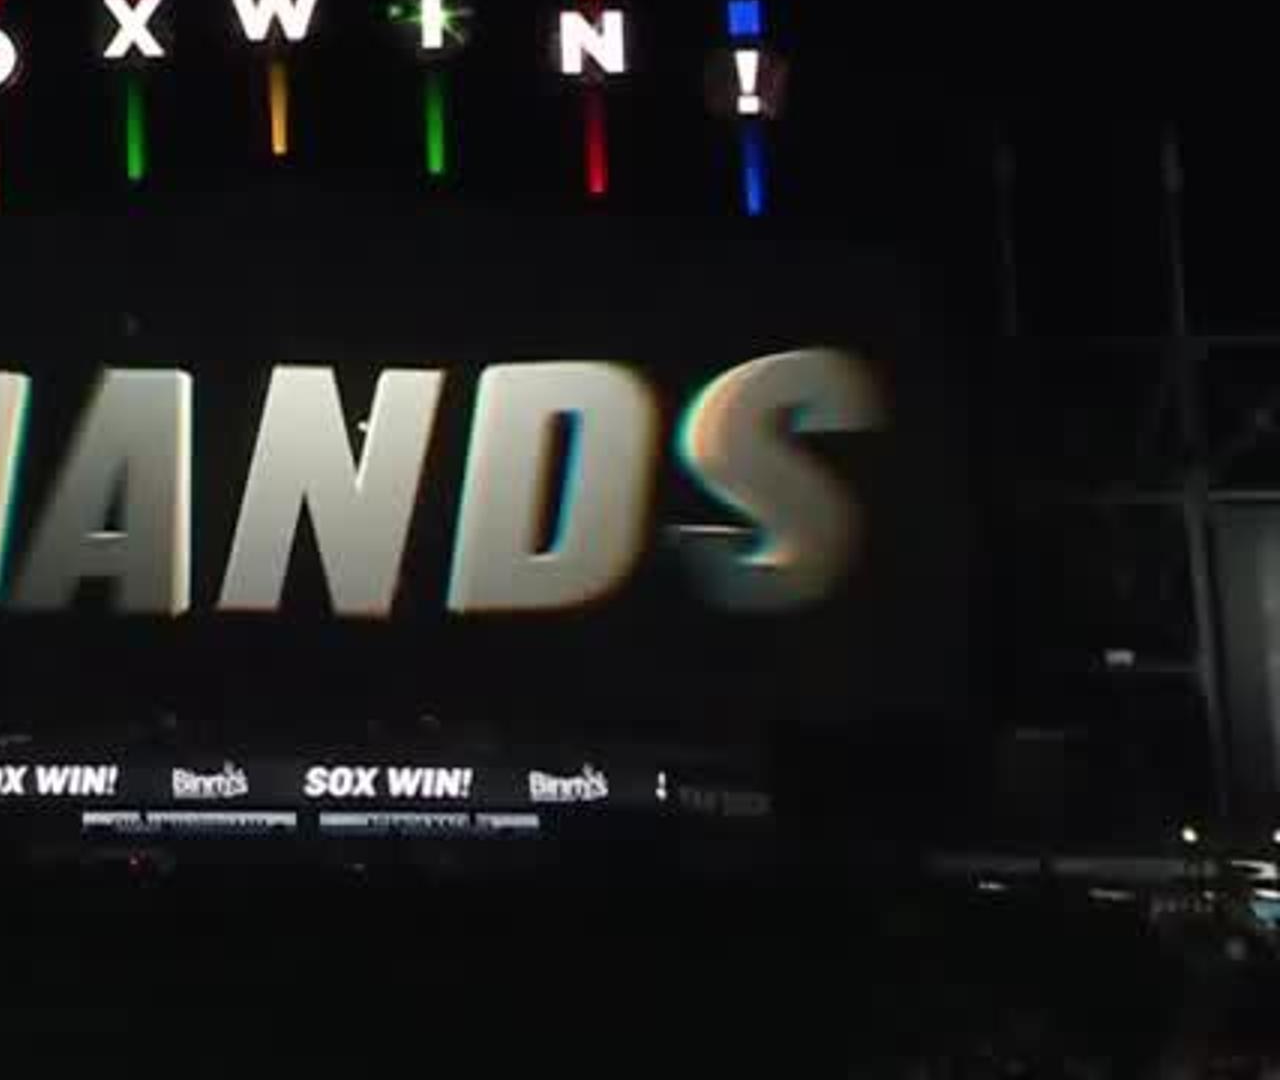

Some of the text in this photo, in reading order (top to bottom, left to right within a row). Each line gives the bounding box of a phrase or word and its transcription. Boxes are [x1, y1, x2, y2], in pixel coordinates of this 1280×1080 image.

[35, 764, 120, 797] WIN!
[304, 766, 379, 798] SOX
[386, 766, 474, 799] WIN!
